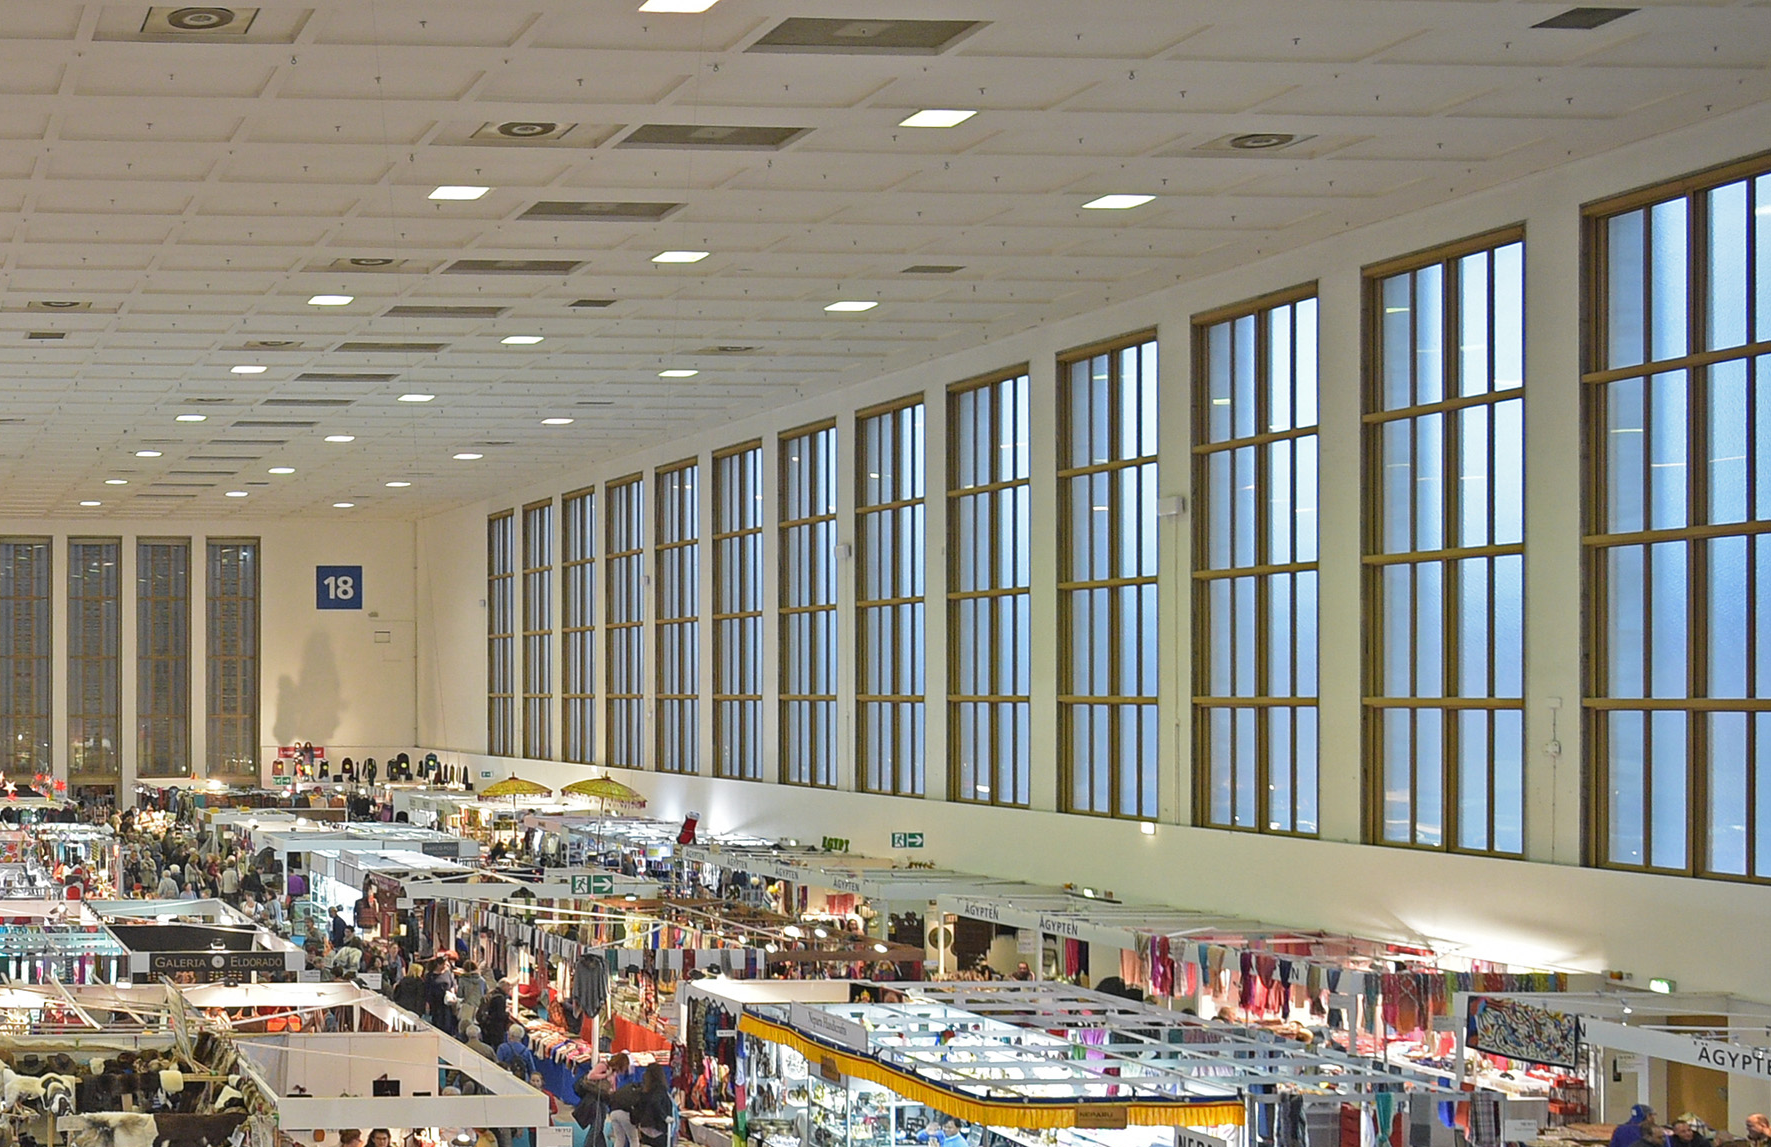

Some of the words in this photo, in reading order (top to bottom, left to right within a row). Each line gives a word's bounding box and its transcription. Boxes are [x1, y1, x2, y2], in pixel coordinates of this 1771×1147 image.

[323, 576, 354, 600] 18
[822, 836, 850, 853] EGYPT
[964, 902, 999, 920] ÄGYPTEN
[1039, 914, 1078, 936] ÄGYPTEN
[154, 956, 206, 968] GALERIA
[230, 955, 283, 967] ELDORADO
